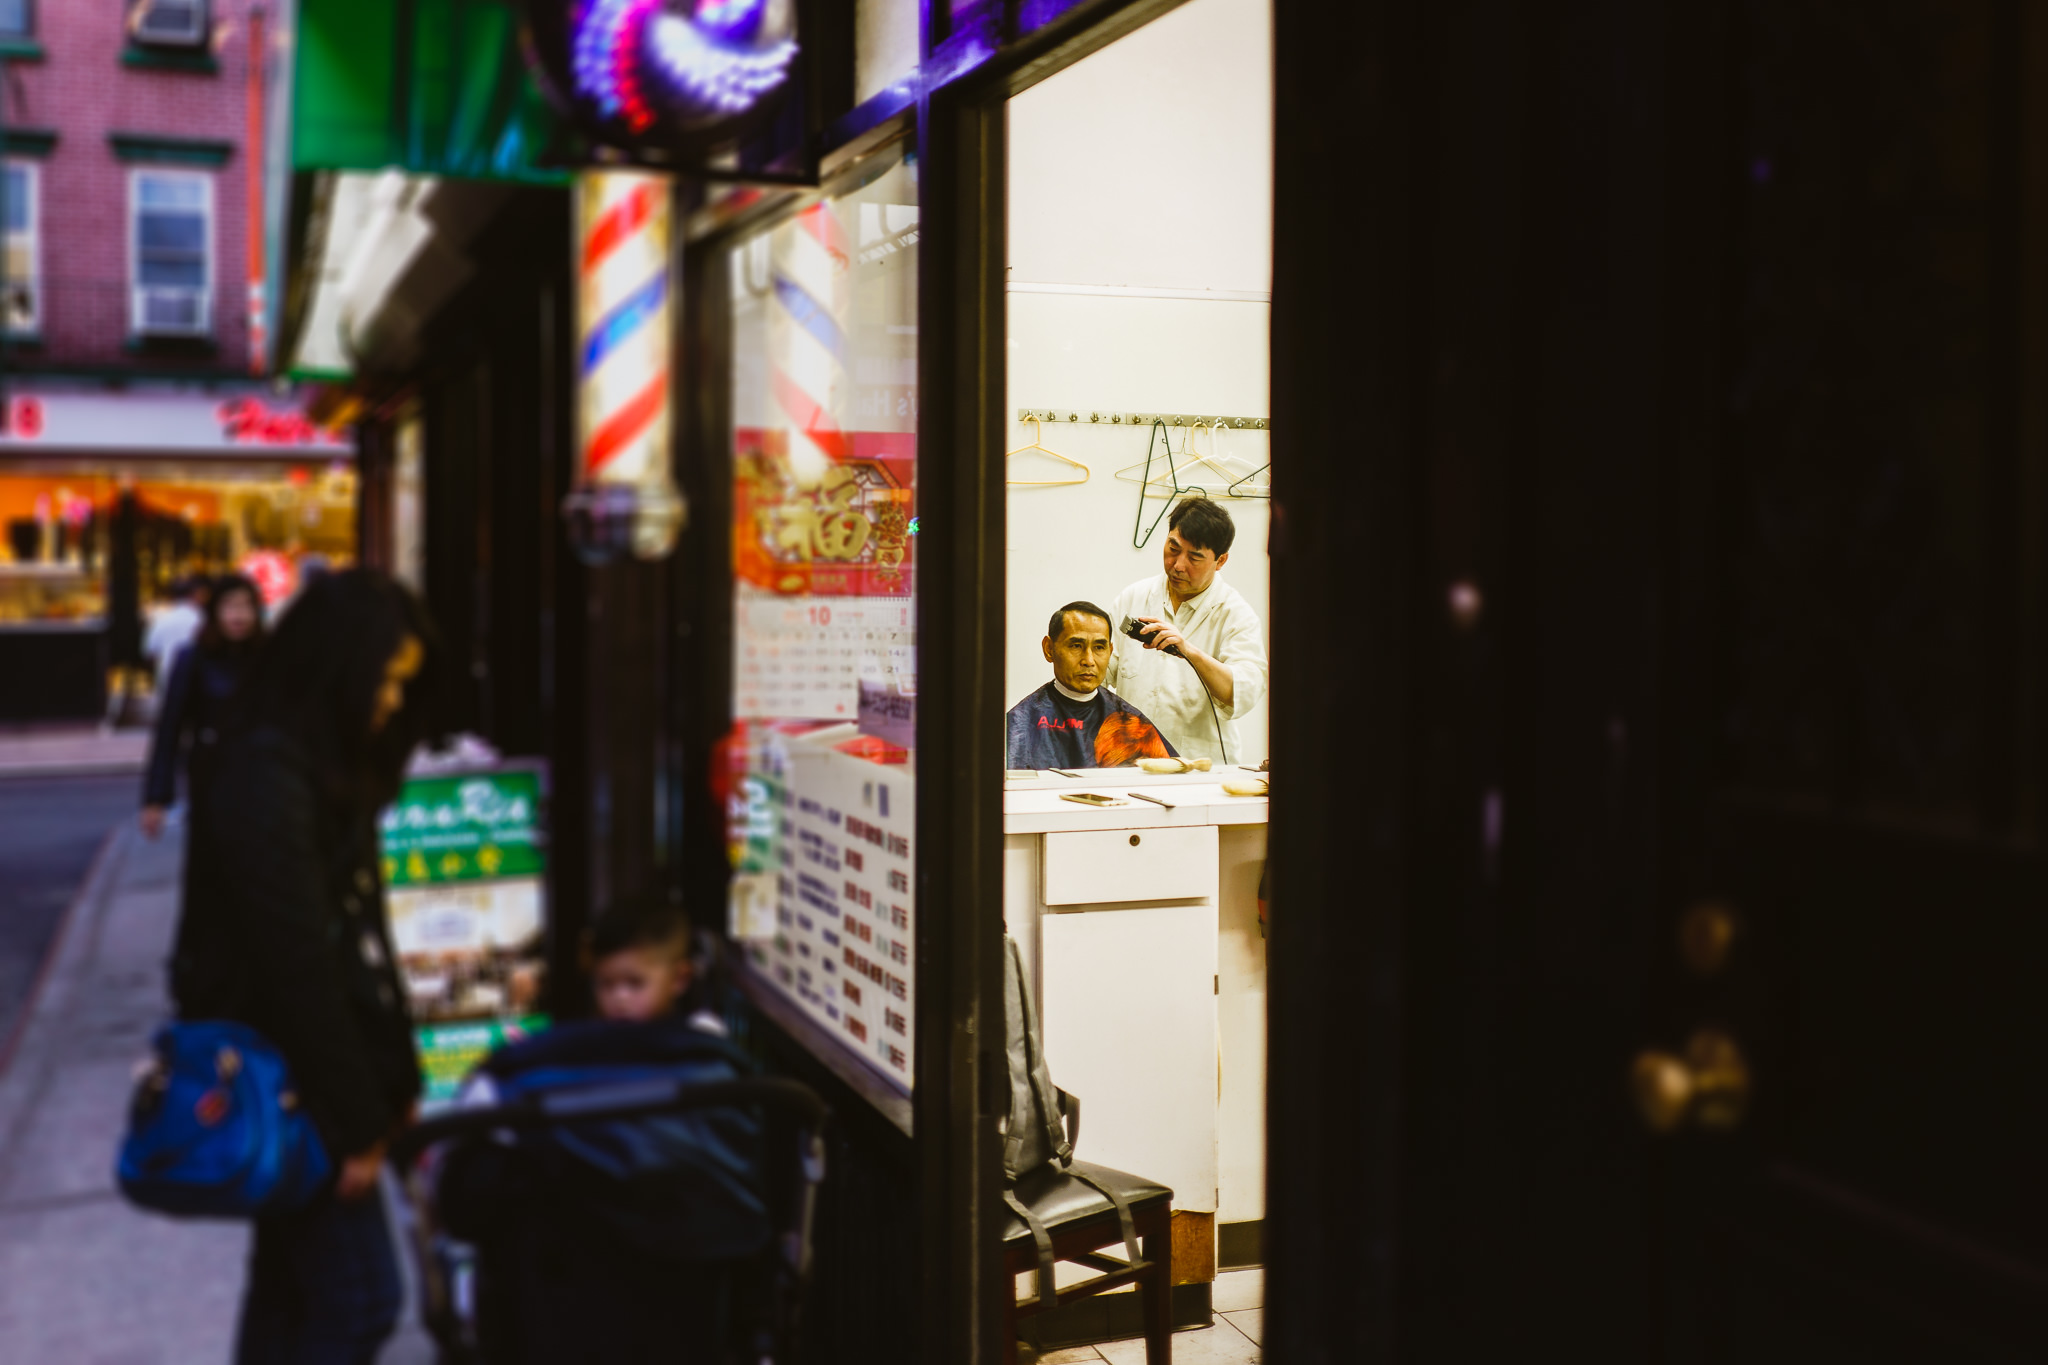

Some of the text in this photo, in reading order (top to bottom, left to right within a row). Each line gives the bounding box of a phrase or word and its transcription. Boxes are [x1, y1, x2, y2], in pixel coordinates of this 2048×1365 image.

[808, 605, 832, 626] 10
[890, 632, 897, 640] 7
[888, 649, 900, 657] 14
[887, 665, 899, 673] 21
